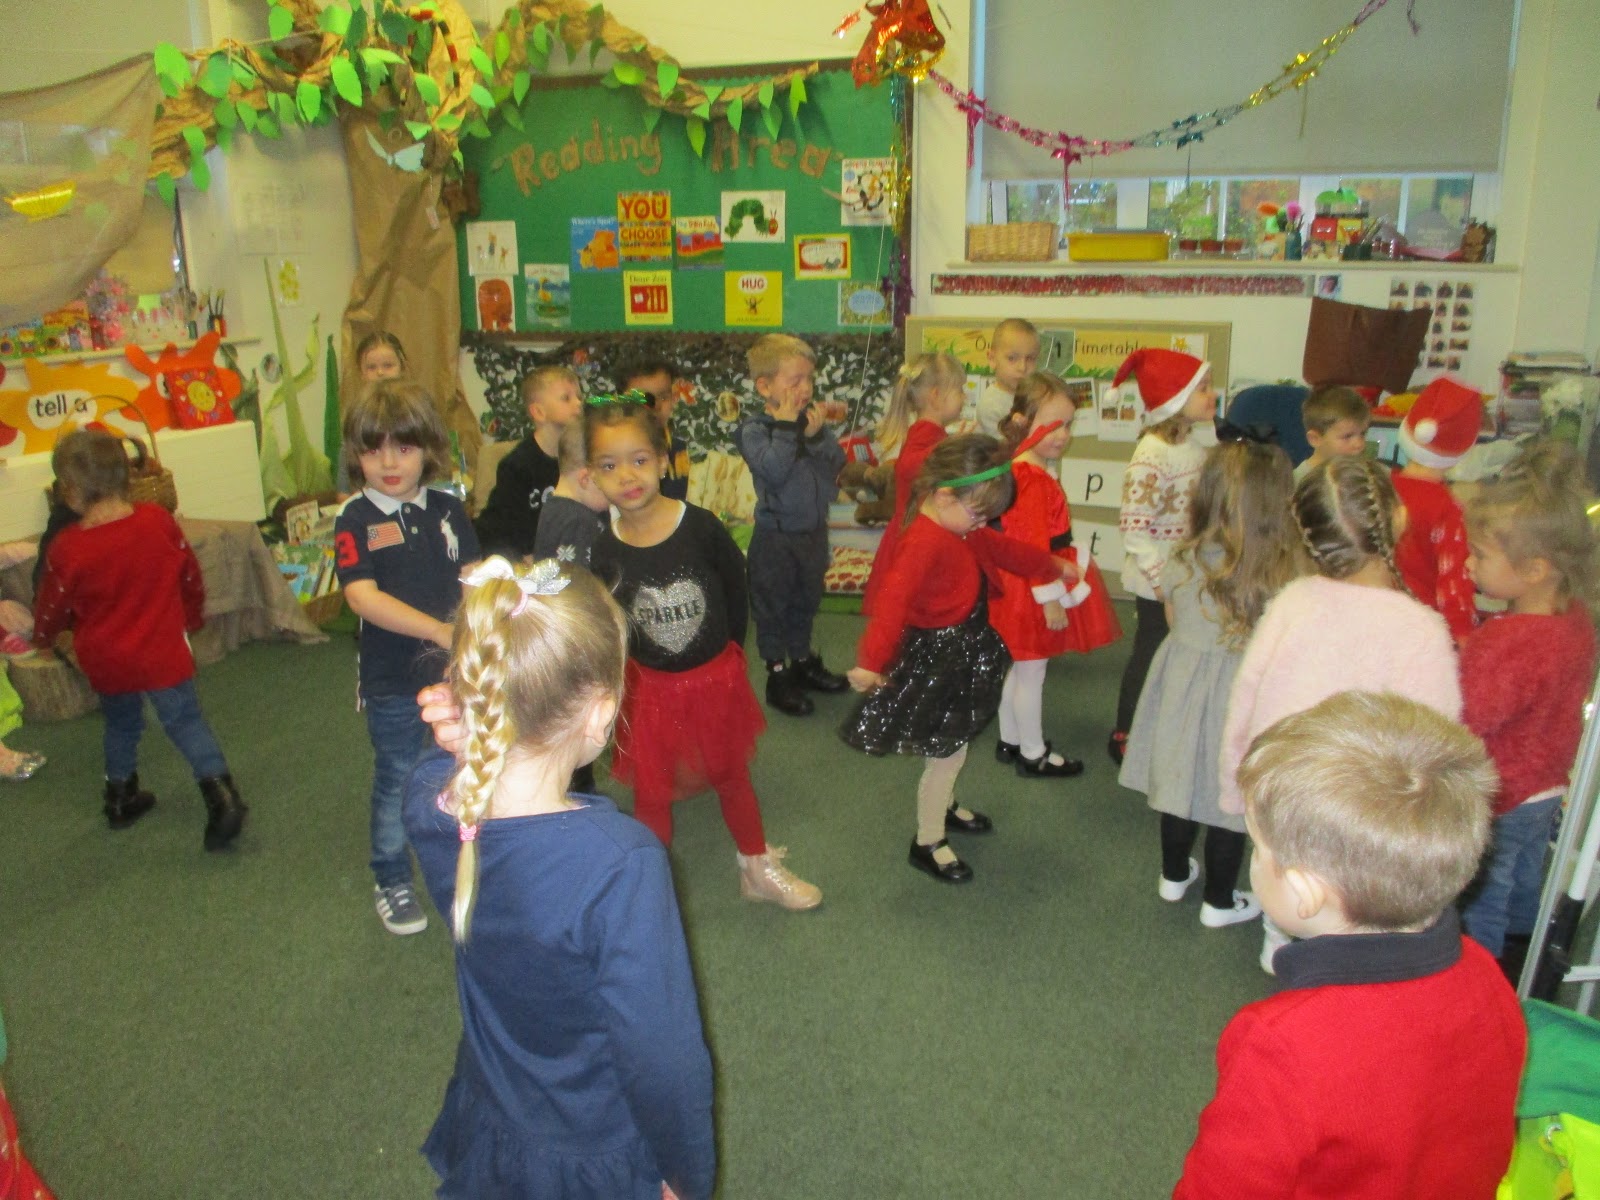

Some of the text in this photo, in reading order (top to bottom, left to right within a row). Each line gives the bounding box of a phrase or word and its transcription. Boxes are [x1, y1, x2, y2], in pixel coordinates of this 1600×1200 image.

[510, 116, 832, 197] Reading Area
[620, 198, 667, 220] YOU
[620, 228, 667, 241] CHOOSE
[741, 276, 765, 290] HUG
[35, 393, 88, 418] tell a
[1085, 472, 1104, 502] p
[335, 531, 359, 568] 3
[1090, 531, 1101, 556] t
[638, 600, 703, 625] SPARKLE
